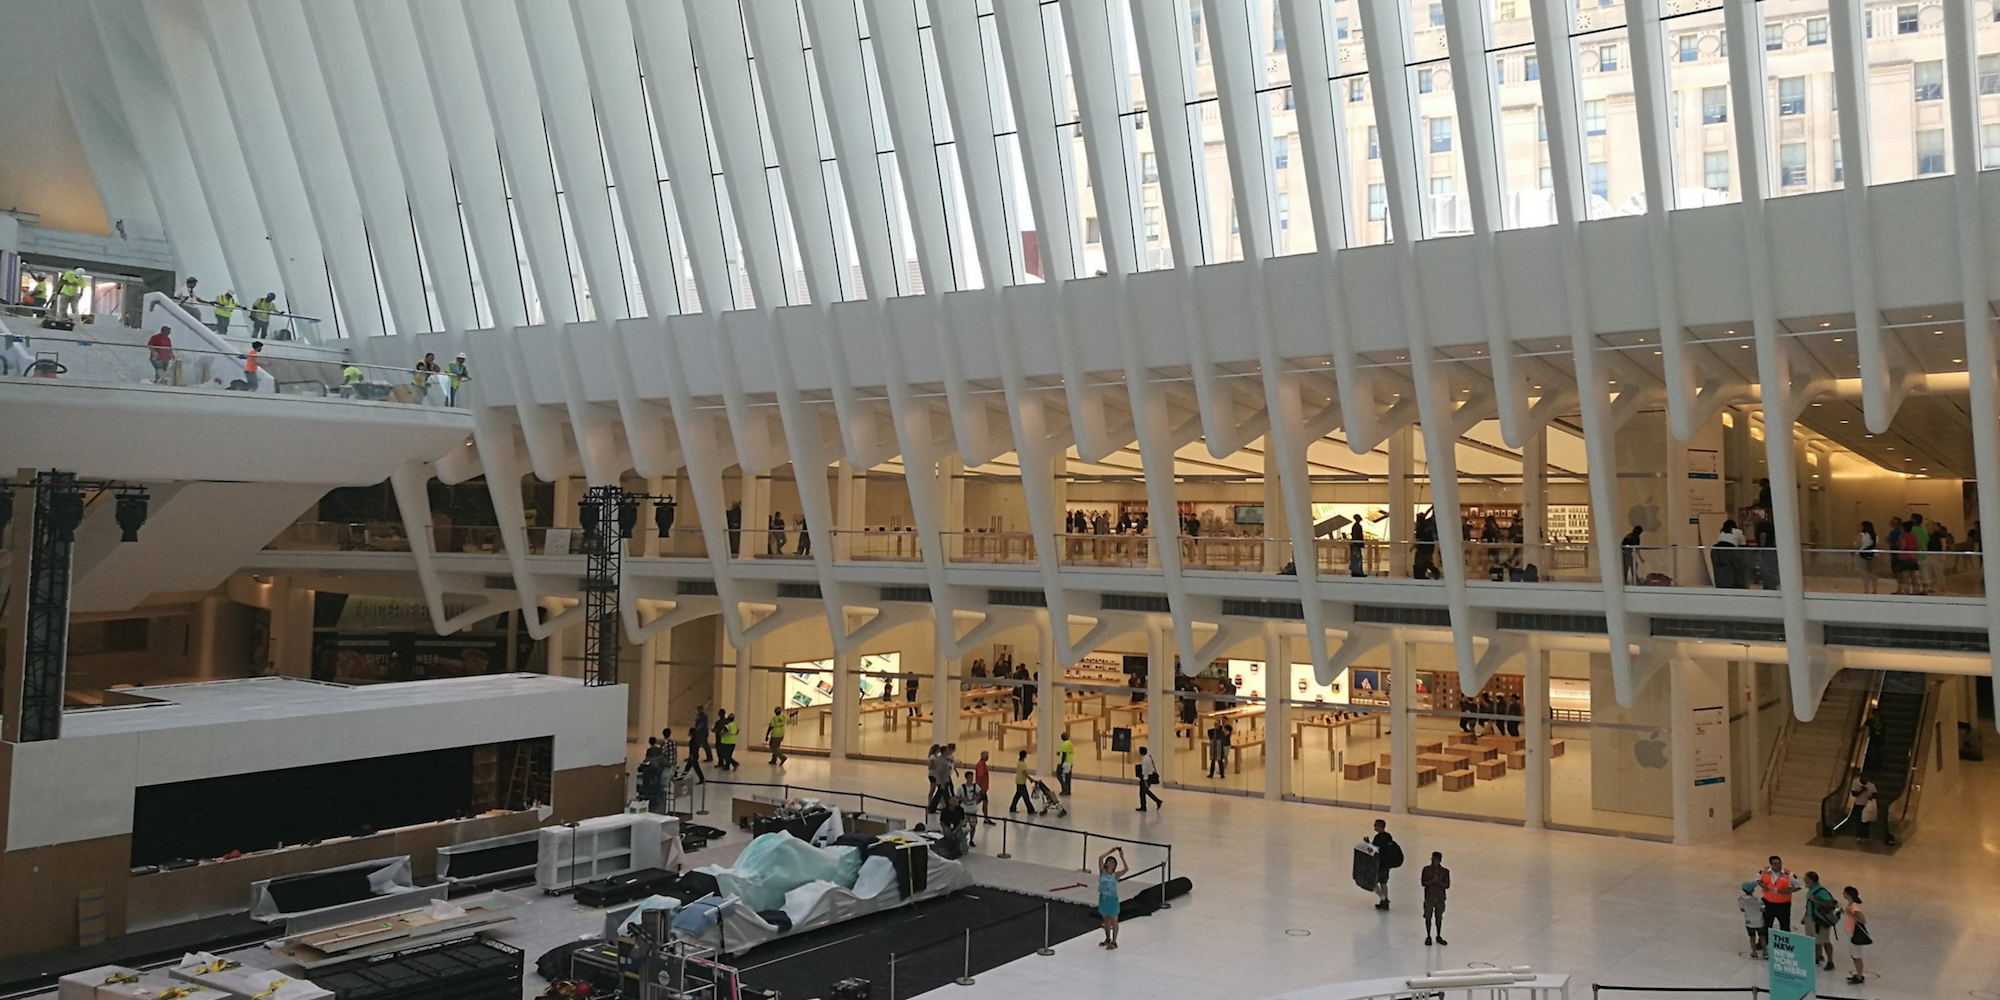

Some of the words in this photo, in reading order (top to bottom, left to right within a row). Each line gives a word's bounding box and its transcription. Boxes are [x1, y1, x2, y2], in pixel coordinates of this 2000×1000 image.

[1773, 934, 1790, 943] THE
[1773, 942, 1795, 951] NEW
[1773, 949, 1795, 959] NEW
[1773, 956, 1798, 967] YORK
[1774, 963, 1782, 971] IS
[1784, 965, 1807, 977] HERE
